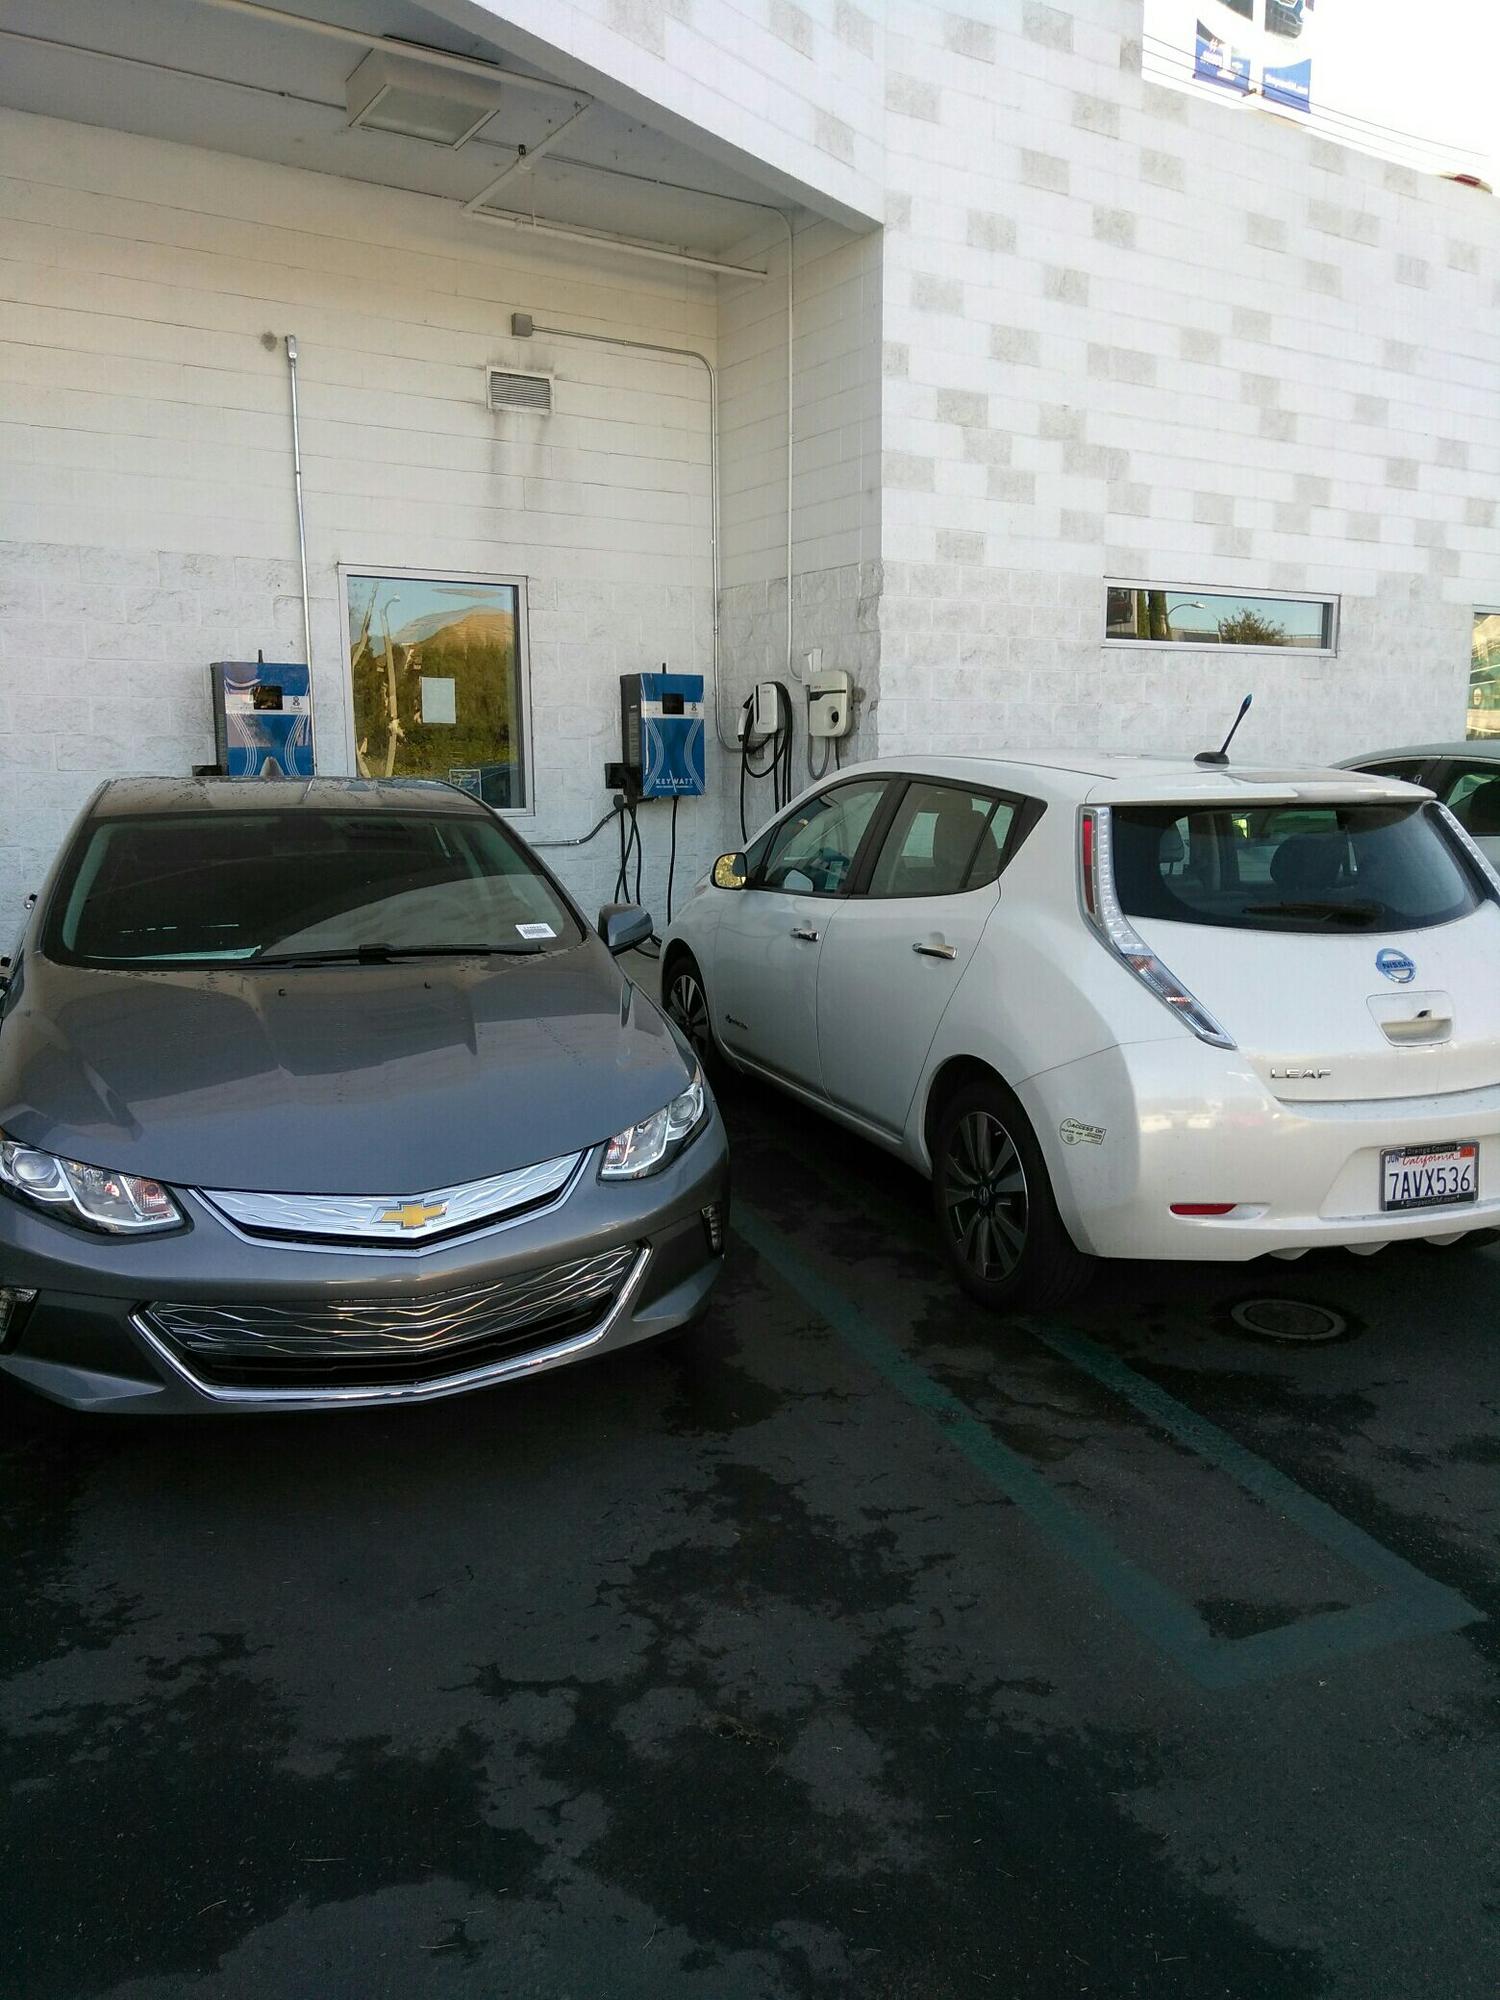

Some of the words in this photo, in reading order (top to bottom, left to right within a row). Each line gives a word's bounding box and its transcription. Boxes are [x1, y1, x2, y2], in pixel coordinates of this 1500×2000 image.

[1381, 960, 1414, 969] NISSAN
[1270, 1069, 1332, 1079] LEAF
[1401, 1153, 1456, 1168] California
[1389, 1165, 1471, 1199] 7AVX536
